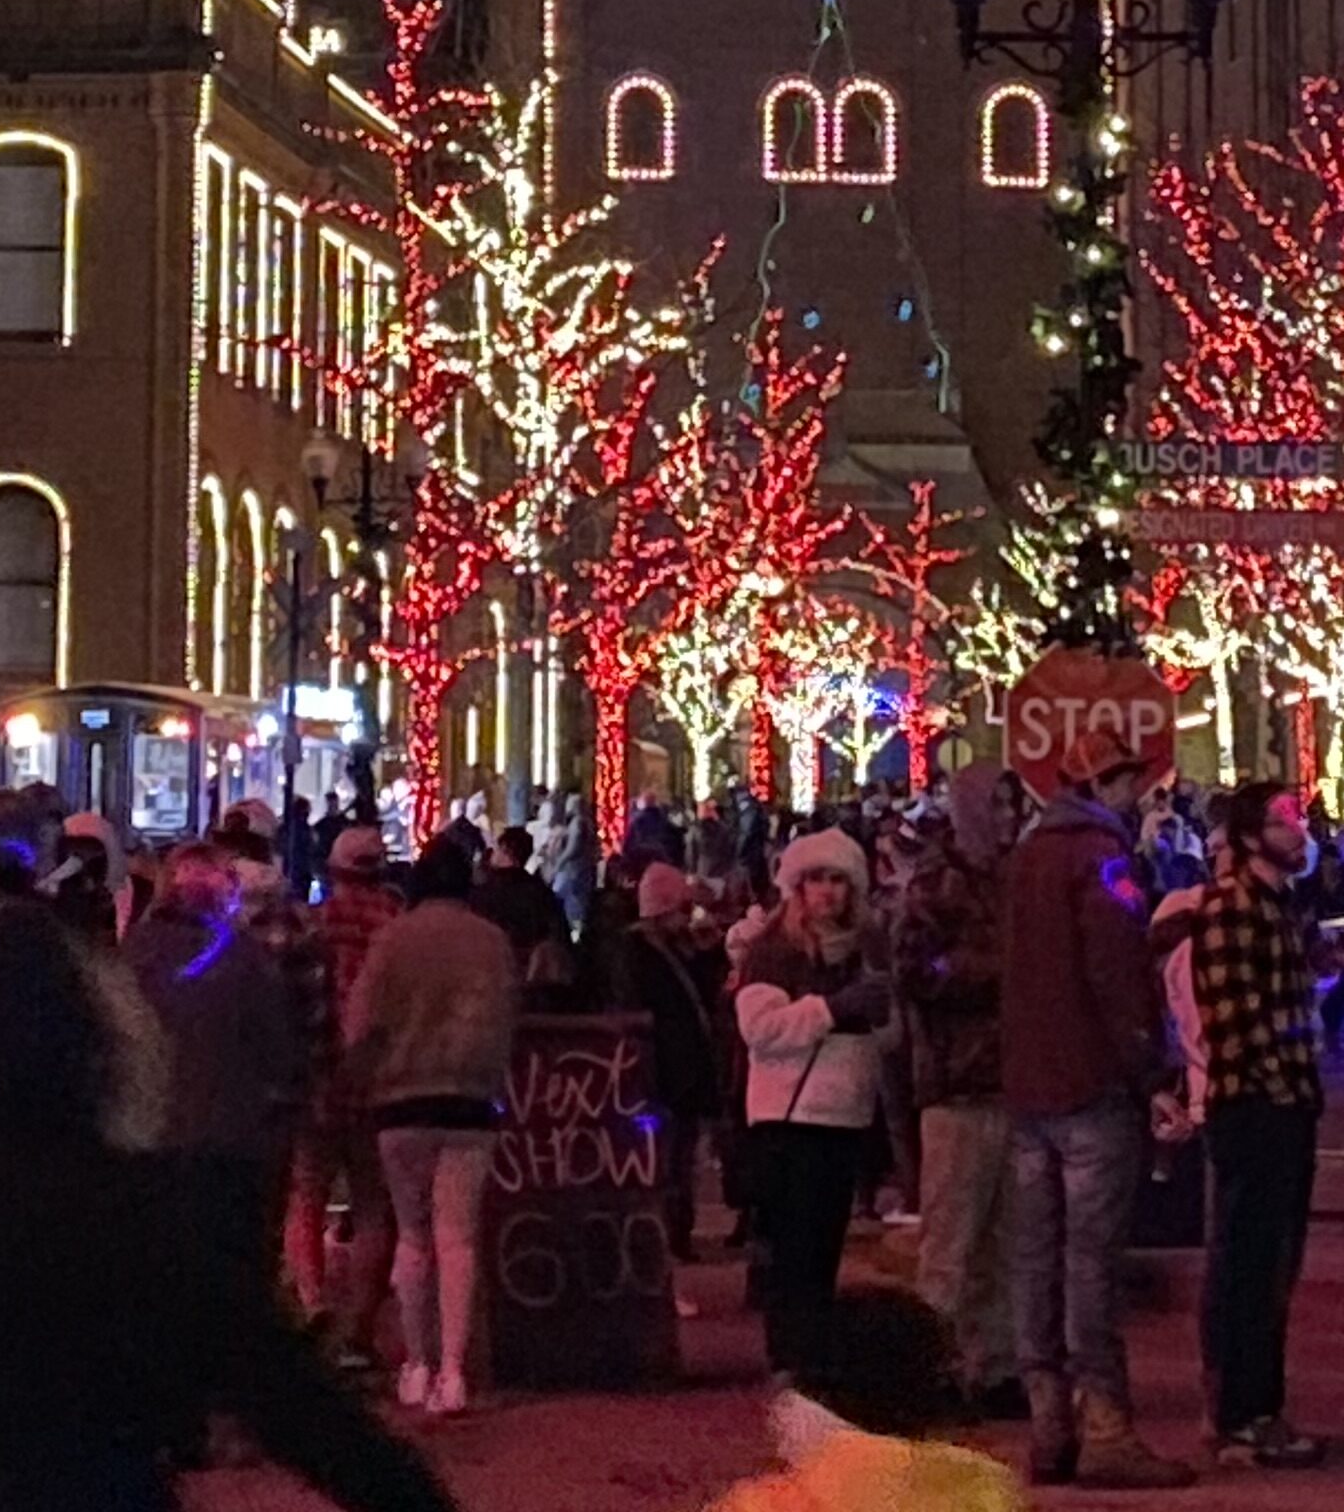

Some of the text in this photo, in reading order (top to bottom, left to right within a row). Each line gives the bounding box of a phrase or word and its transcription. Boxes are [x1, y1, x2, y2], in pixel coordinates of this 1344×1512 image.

[1237, 442, 1336, 475] PLACE
[1017, 697, 1165, 761] STOP
[490, 1123, 655, 1192] SHOW
